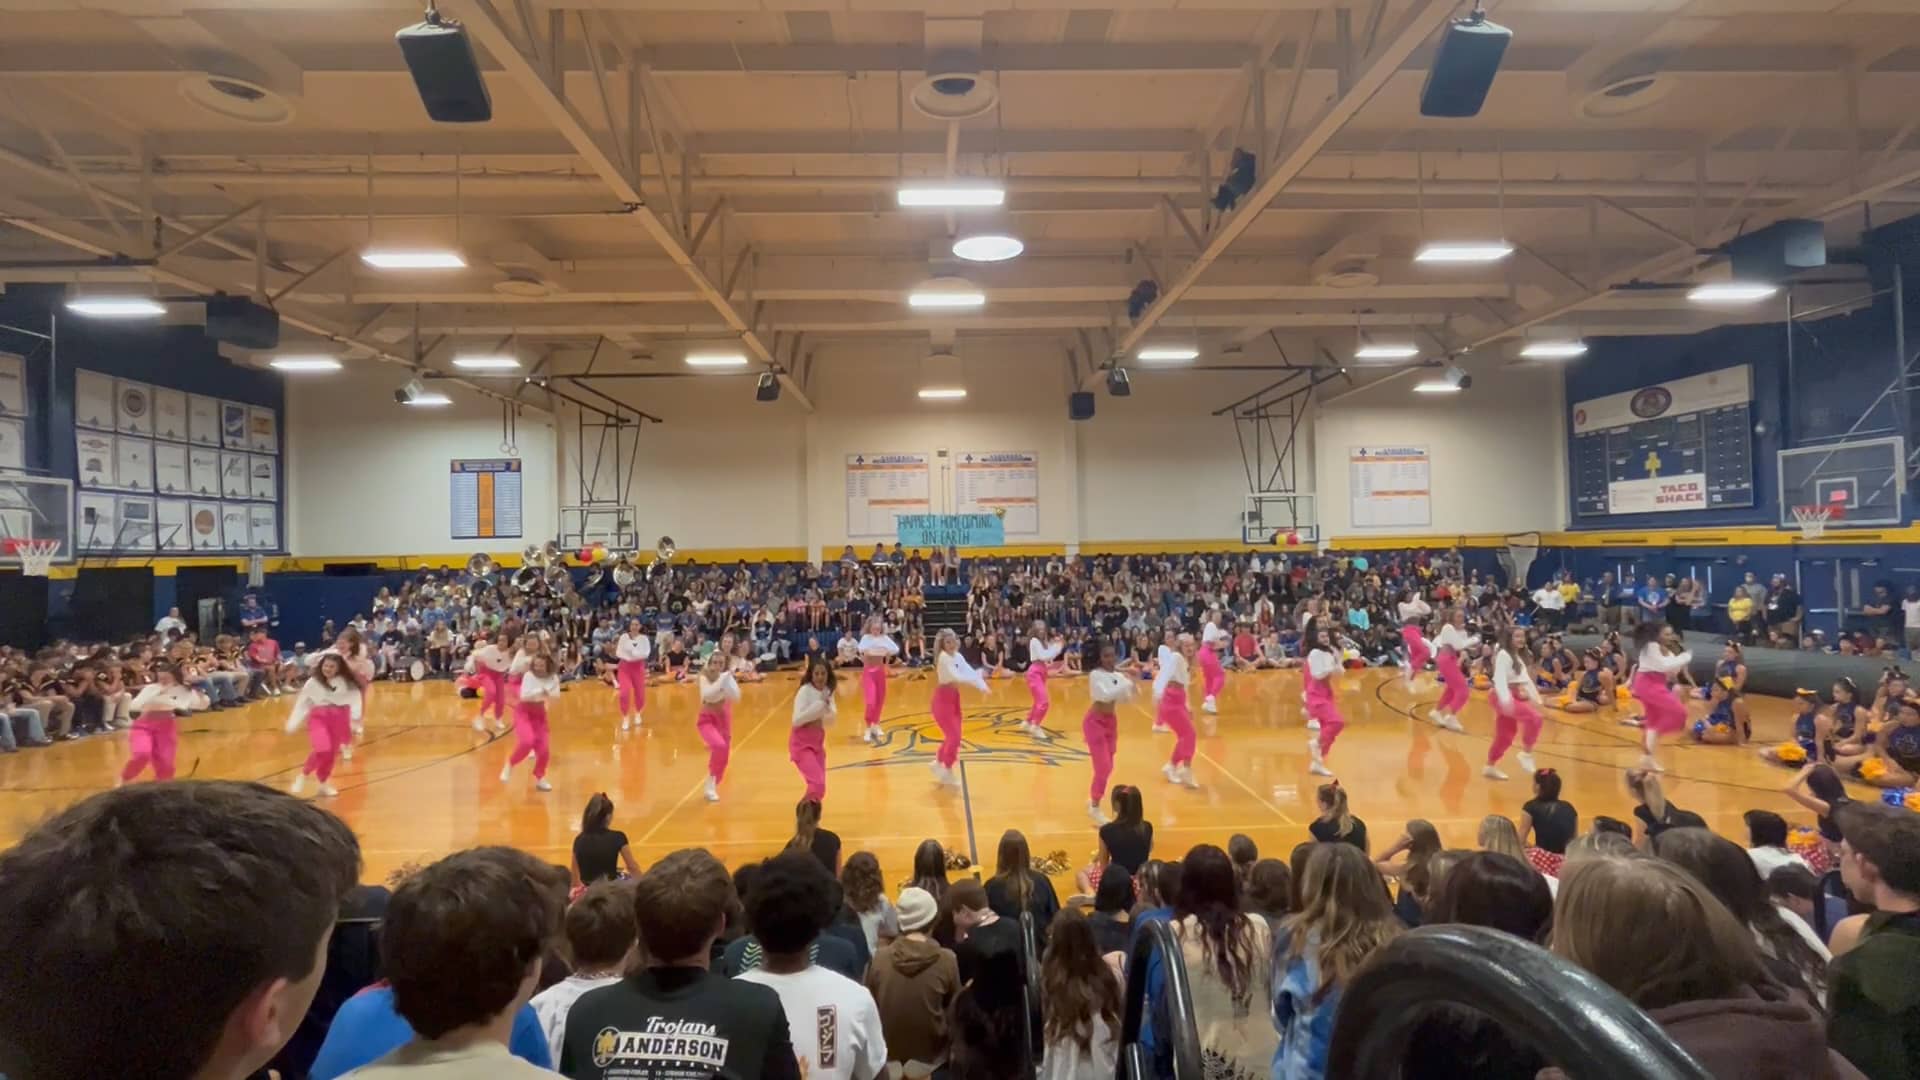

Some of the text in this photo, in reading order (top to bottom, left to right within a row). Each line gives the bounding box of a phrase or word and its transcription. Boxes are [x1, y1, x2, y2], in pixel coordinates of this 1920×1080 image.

[1660, 482, 1698, 494] TACO
[1655, 493, 1704, 504] SHACK
[941, 513, 993, 529] HOMECOMING
[921, 530, 970, 545] ON EARTH
[646, 1015, 717, 1039] Trojans
[622, 1036, 725, 1061] ANDERSON
